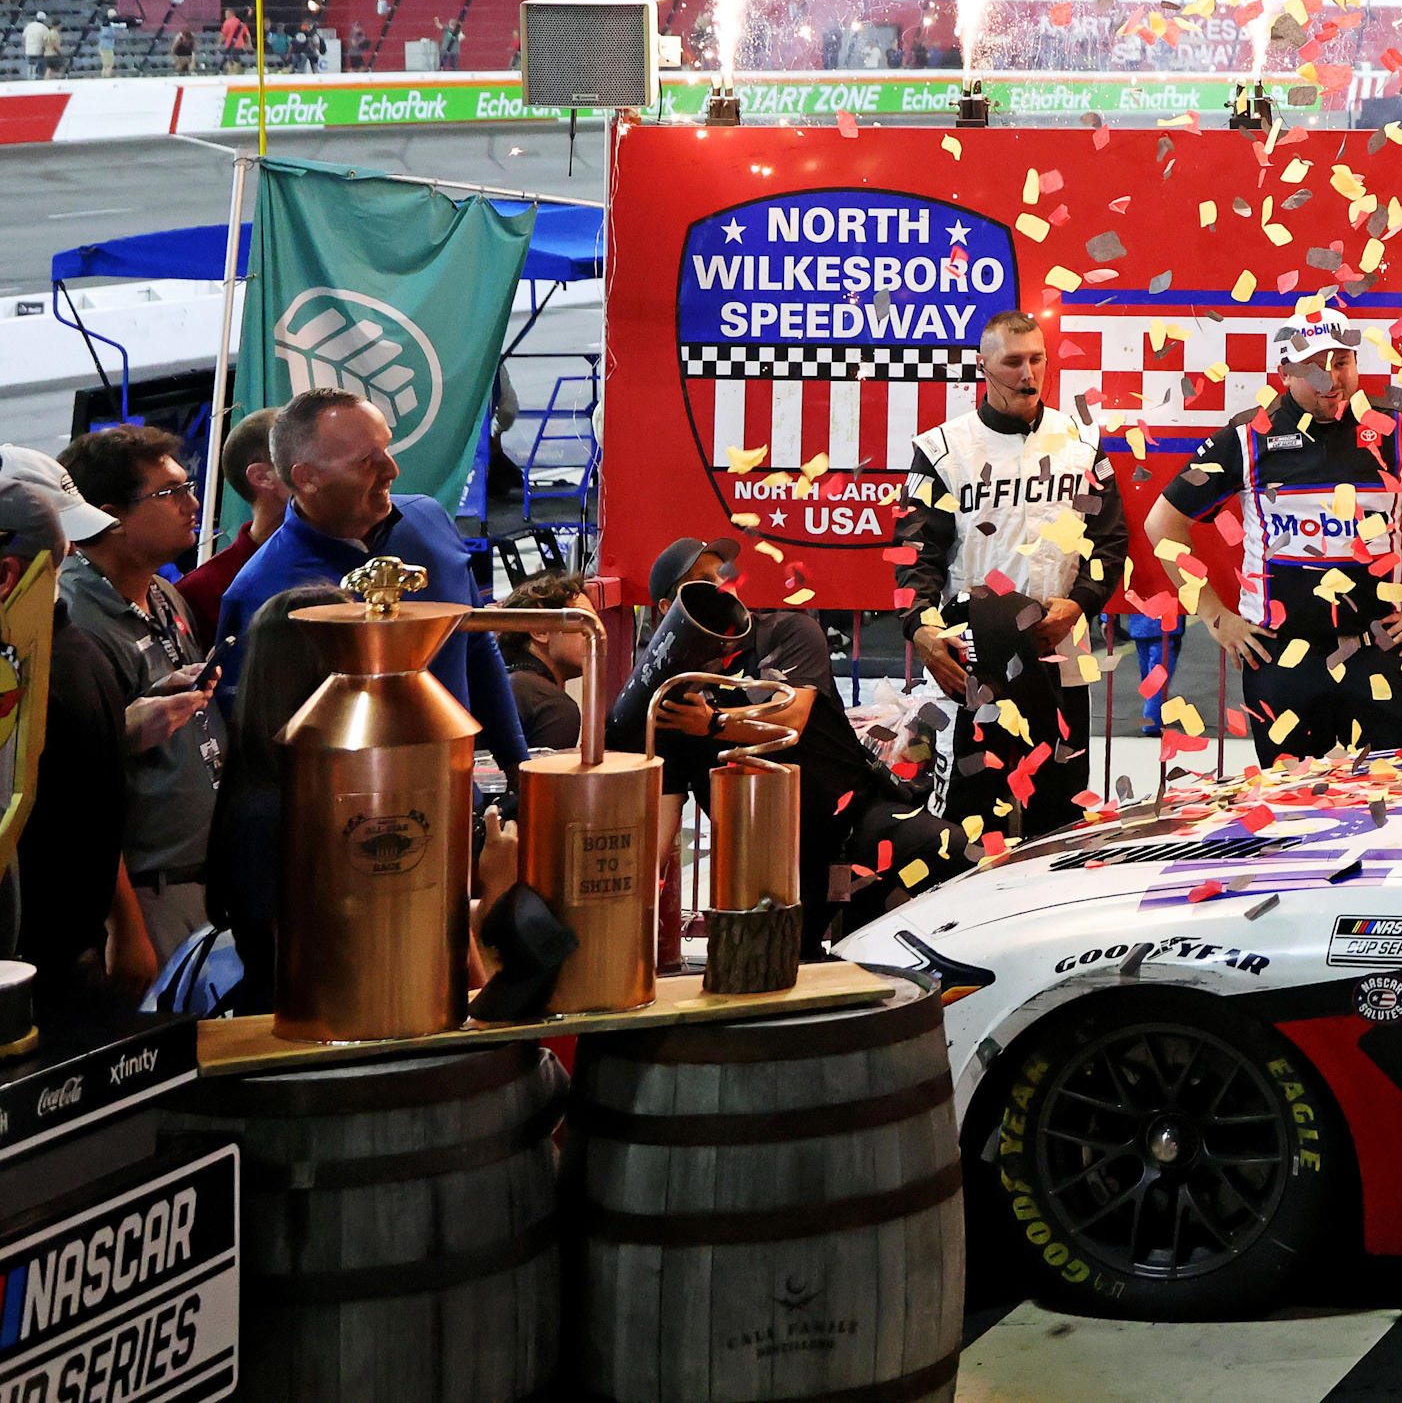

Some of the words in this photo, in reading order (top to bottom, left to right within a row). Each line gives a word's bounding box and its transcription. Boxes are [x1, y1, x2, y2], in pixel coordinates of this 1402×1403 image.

[236, 92, 328, 125] EchoPark
[358, 89, 446, 122] EchoPark
[813, 83, 882, 111] ZONE
[1010, 86, 1092, 111] EchoPark
[1119, 86, 1200, 111] EchoPark
[767, 206, 931, 244] NORTH
[693, 254, 1005, 293] WILKESBORO
[720, 303, 977, 340] SPEEDWAY
[734, 480, 820, 501] NORTH
[804, 506, 883, 536] USA
[583, 834, 632, 851] BORN
[597, 858, 619, 872] TO
[579, 877, 632, 894] SHINE
[1346, 940, 1378, 954] CUP
[109, 1047, 158, 1086] xfinity
[1267, 1057, 1322, 1173] EAGLE
[20, 1186, 197, 1342] NASCAR
[59, 1293, 201, 1403] SERIES
